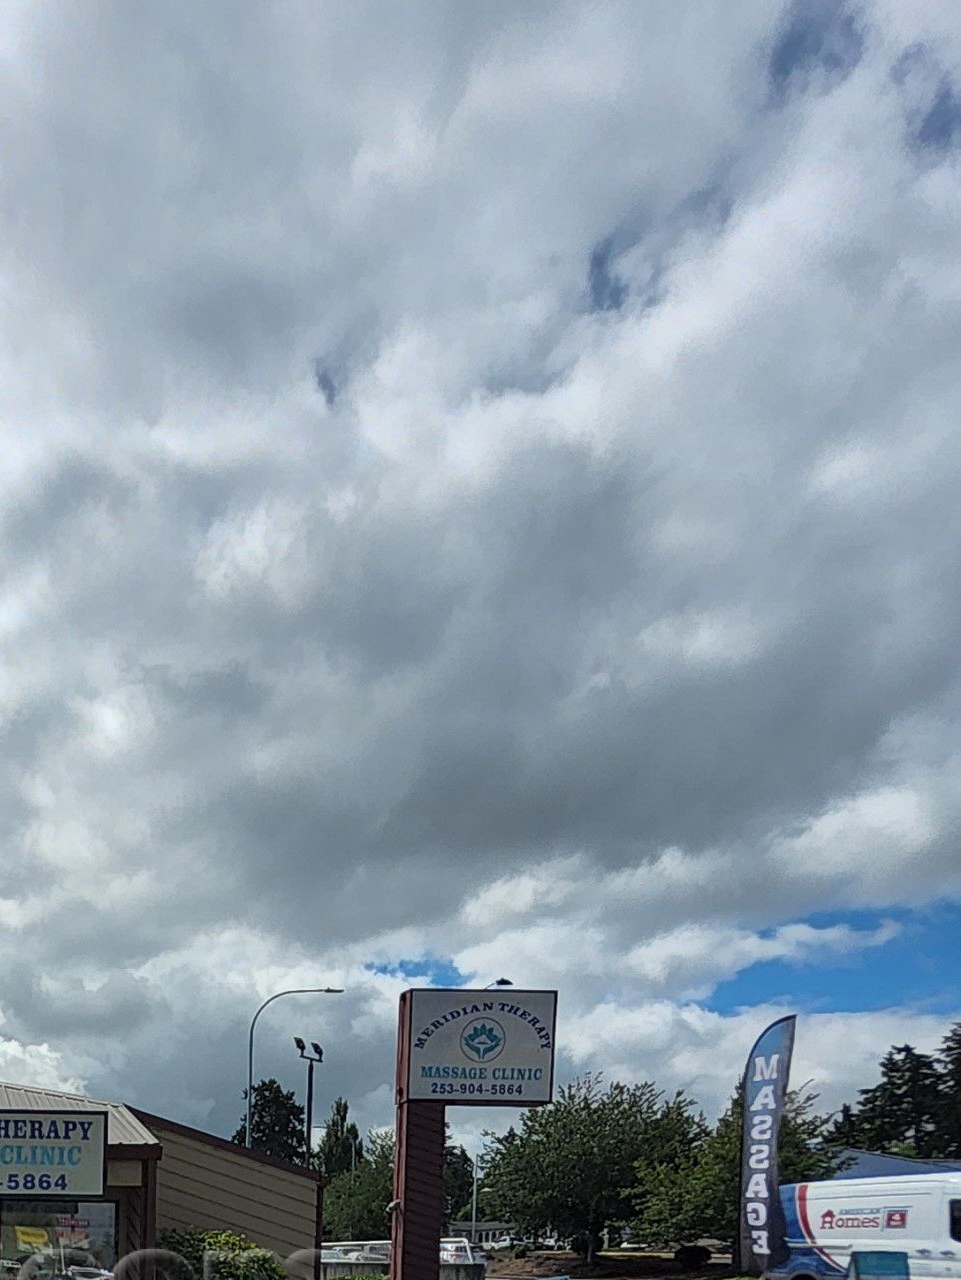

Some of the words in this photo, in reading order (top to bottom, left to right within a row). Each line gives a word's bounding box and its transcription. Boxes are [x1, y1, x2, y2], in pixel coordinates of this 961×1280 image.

[414, 1002, 494, 1050] MERIDIAN
[498, 1002, 552, 1050] THERAPY
[421, 1065, 487, 1080] MASSAGE
[492, 1067, 543, 1081] CLINIC
[431, 1082, 523, 1096] 253-904-5864
[0, 1144, 83, 1166] CLINIC
[820, 1208, 880, 1230] Homes
